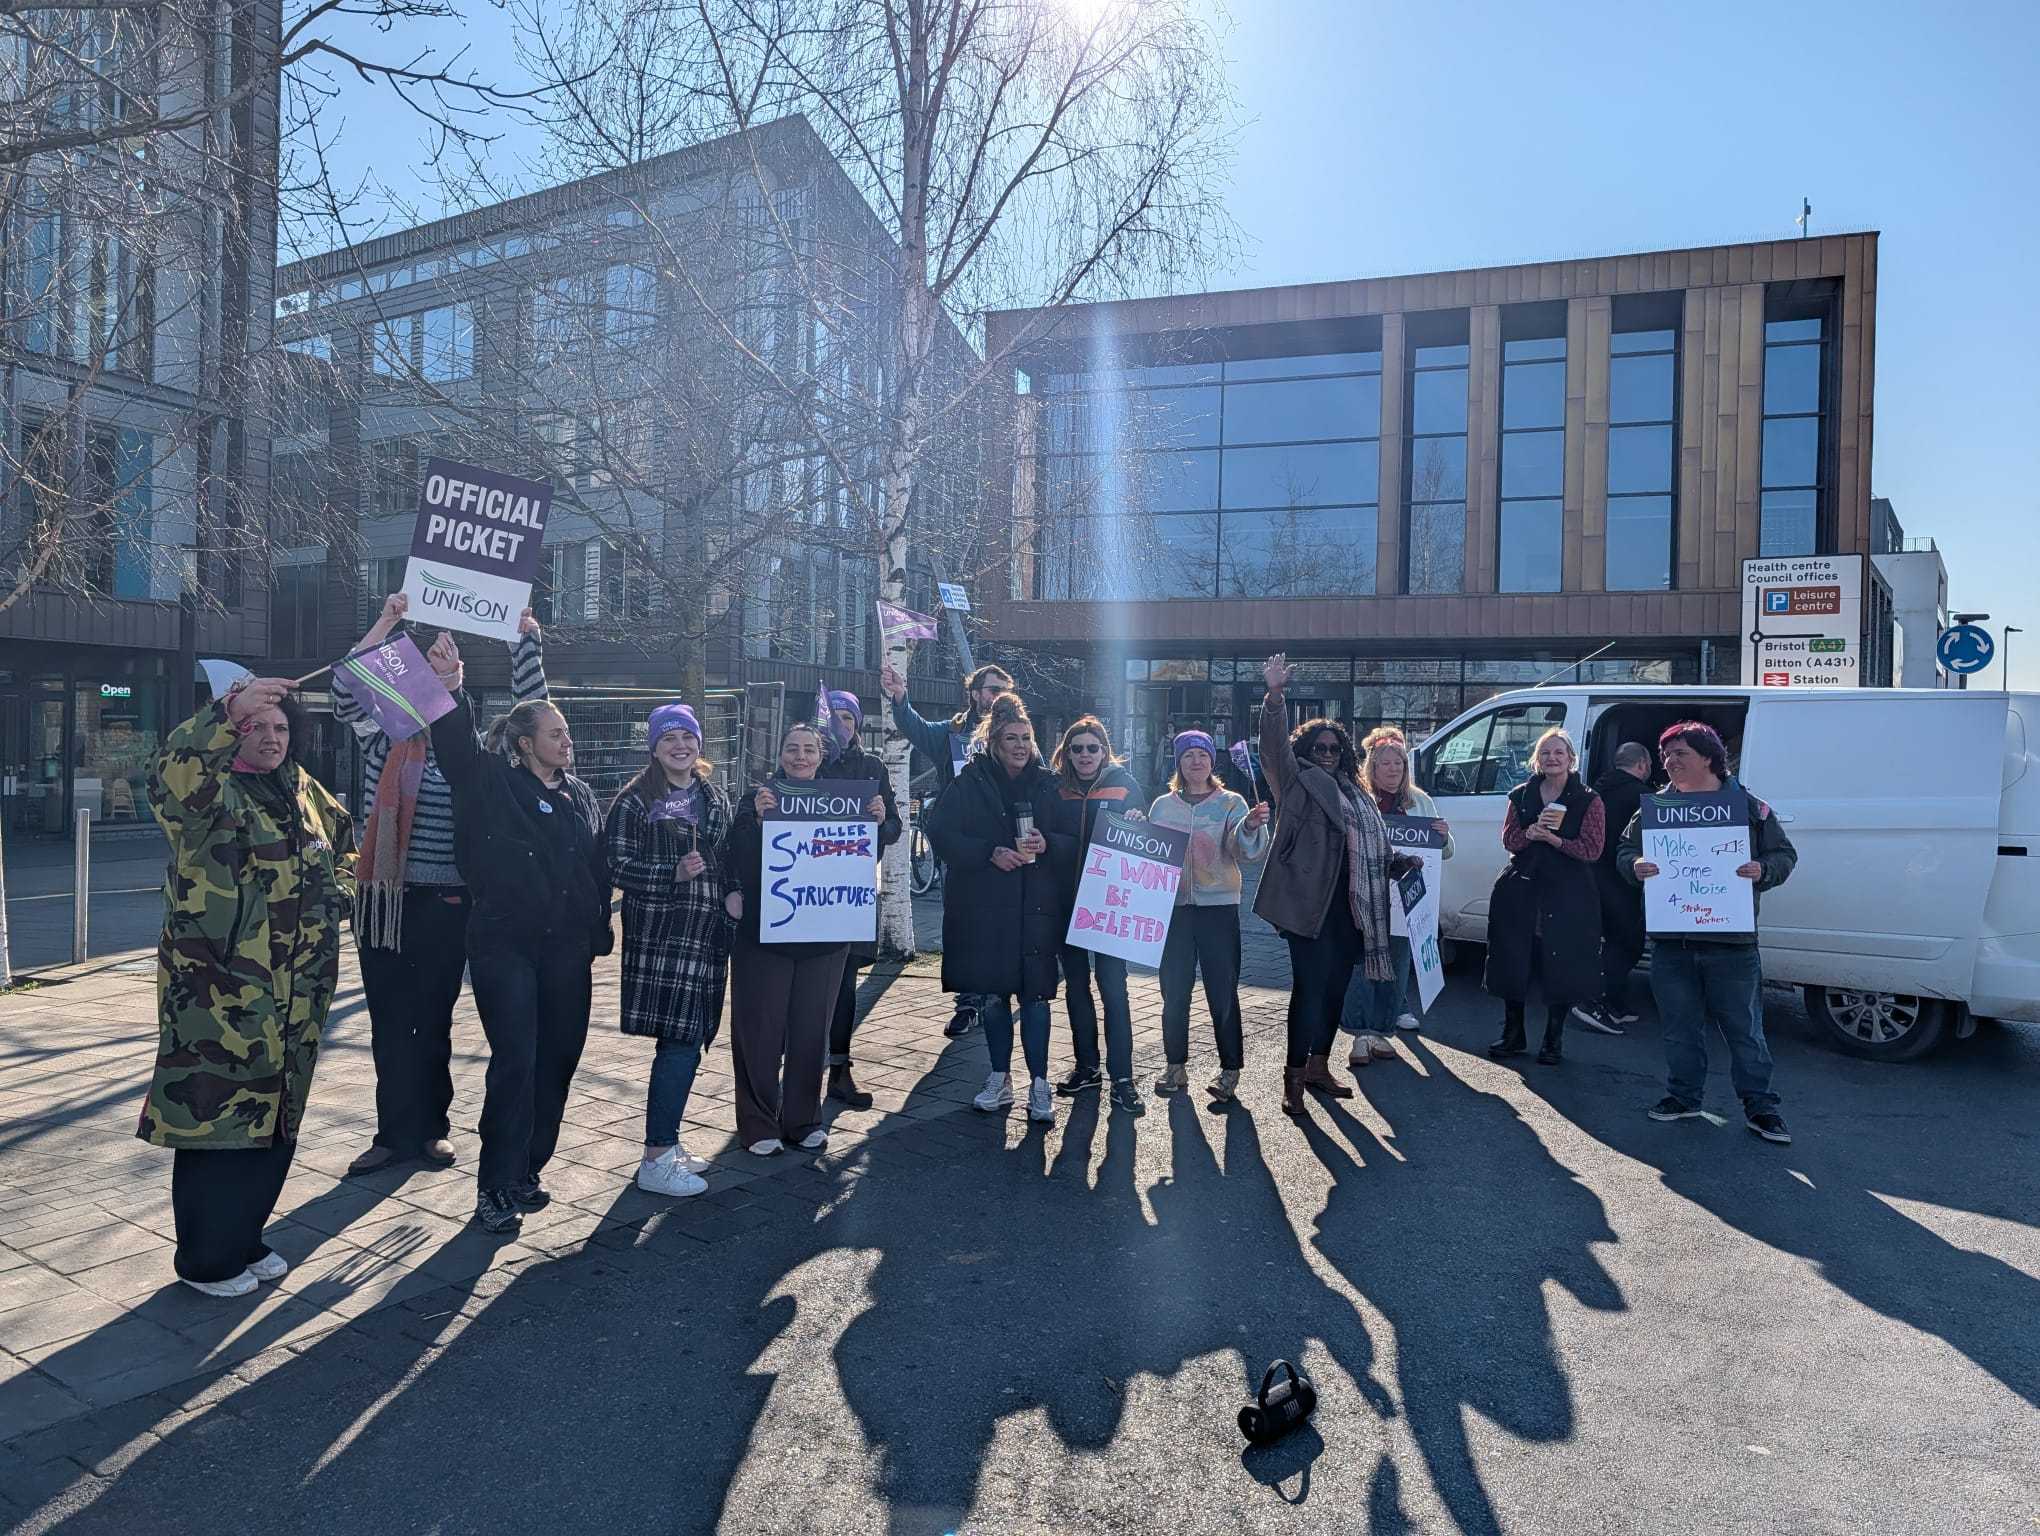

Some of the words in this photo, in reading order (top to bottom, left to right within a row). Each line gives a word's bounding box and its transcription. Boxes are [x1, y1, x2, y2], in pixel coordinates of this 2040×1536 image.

[426, 475, 543, 530] OFFICIAL
[426, 514, 524, 563] PICKET
[1748, 562, 1787, 573] Health
[1792, 561, 1831, 570] centre
[1748, 573, 1792, 583] Council
[1797, 572, 1838, 581] offices
[422, 587, 509, 621] UNISON
[1794, 590, 1836, 600] Leisure
[1795, 602, 1833, 611] centre
[1765, 642, 1805, 651] Bristol
[1811, 640, 1844, 651] (A4)
[379, 644, 408, 676] ISON
[1765, 659, 1802, 667] Bitton
[1794, 674, 1839, 684] Station
[101, 683, 130, 696] Open
[781, 796, 861, 815] UNISON
[1657, 805, 1731, 823] UNISON
[1106, 827, 1172, 857] UNISON
[1386, 828, 1430, 842] ISON
[1653, 832, 1698, 858] Make
[1086, 847, 1112, 877] I
[1120, 857, 1183, 894] WONT
[1669, 859, 1712, 879] Some
[1105, 884, 1132, 907] BE
[1690, 880, 1727, 895] Noise
[1668, 893, 1682, 906] 4
[1074, 907, 1164, 942] DELETED
